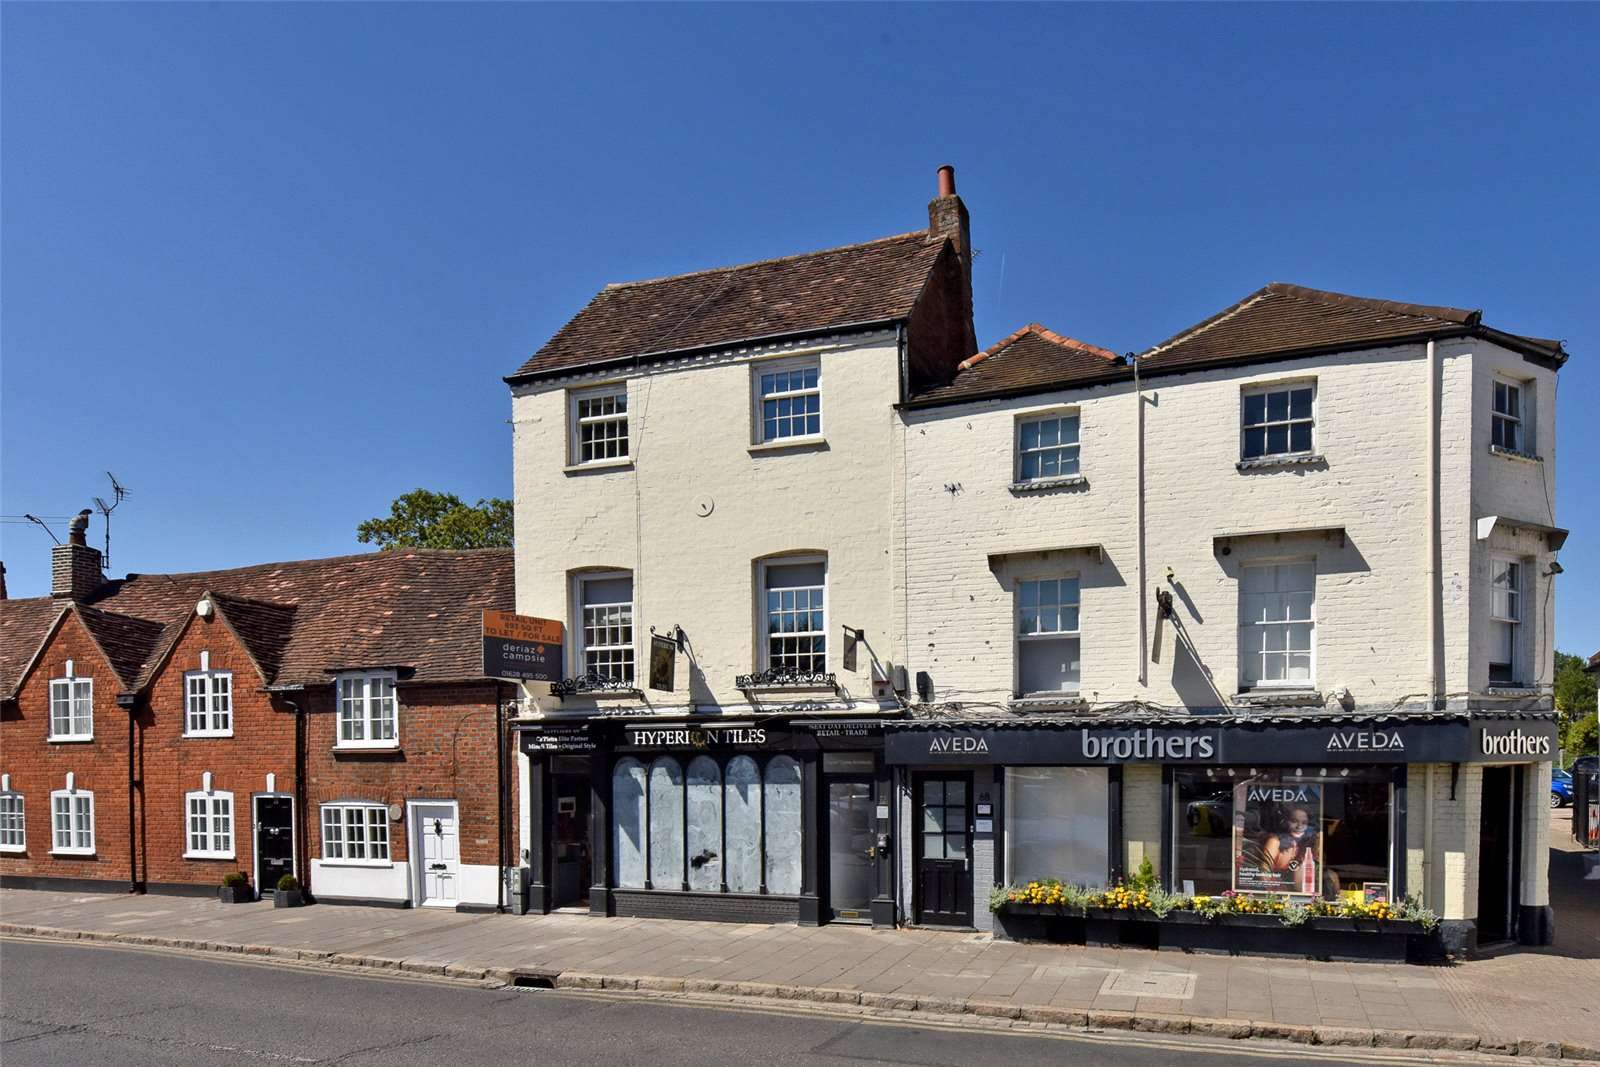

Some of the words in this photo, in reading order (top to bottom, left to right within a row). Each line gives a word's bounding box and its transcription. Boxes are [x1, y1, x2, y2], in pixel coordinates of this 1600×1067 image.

[523, 631, 540, 640] FOR
[541, 634, 560, 642] SALE
[502, 643, 535, 654] deriaz
[502, 652, 545, 663] campsie
[723, 728, 765, 743] TILES
[1327, 731, 1404, 748] AVEDA
[1482, 728, 1550, 754] brothers
[930, 737, 989, 751] AVEDA
[1082, 728, 1214, 758] brothers
[1248, 789, 1308, 802] AVEDA
